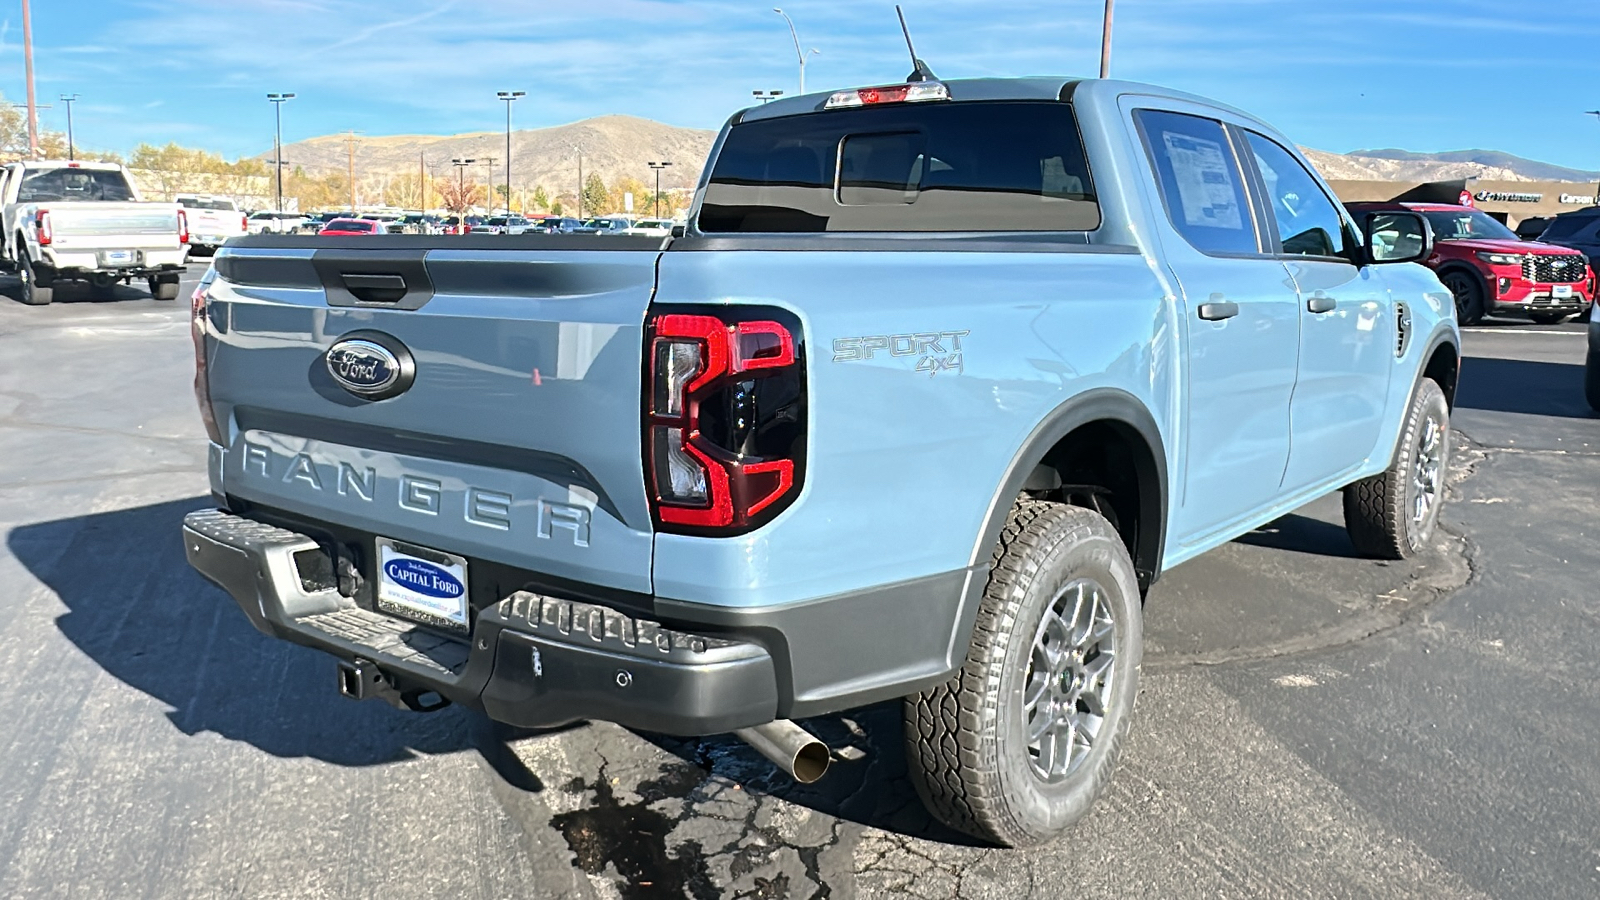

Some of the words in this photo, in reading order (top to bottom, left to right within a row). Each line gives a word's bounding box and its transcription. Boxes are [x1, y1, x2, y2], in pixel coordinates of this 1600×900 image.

[1560, 193, 1594, 205] Carson
[832, 330, 971, 363] SPORT
[339, 350, 379, 381] Ford
[915, 353, 964, 378] 4x4
[242, 440, 593, 548] RANGER
[389, 564, 431, 587] CAPITAL
[432, 575, 459, 595] FORD
